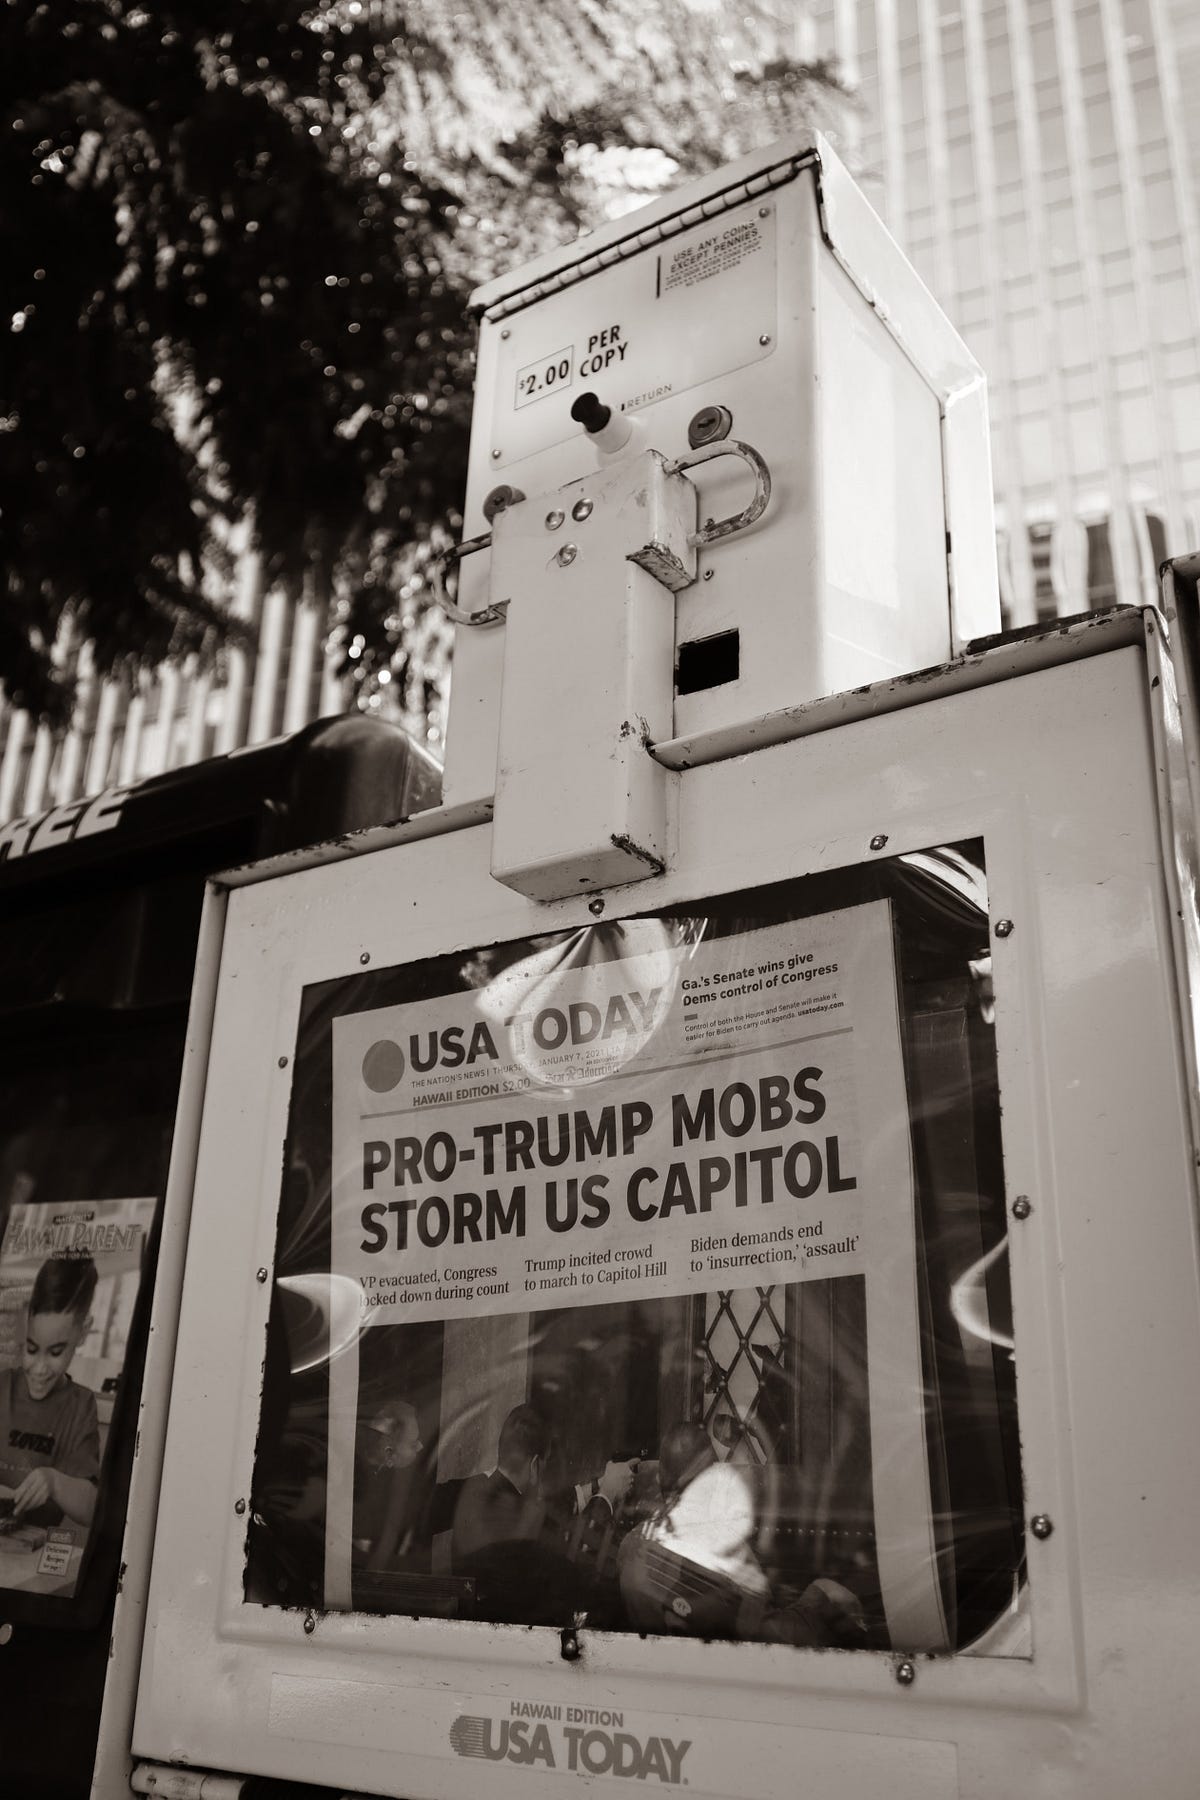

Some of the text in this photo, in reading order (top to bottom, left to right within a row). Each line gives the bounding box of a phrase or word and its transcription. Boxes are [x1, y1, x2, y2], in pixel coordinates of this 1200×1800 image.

[670, 250, 708, 273] EXCEPT
[714, 228, 758, 253] PENNIES
[674, 222, 755, 262] USE ANY COINS
[588, 325, 620, 353] PER
[519, 359, 570, 395] $2.00
[580, 342, 628, 378] COPY
[627, 384, 673, 408] RETURN
[682, 953, 814, 991] Ga.'s Senate wins give
[683, 962, 838, 1006] Dems control of Congress
[410, 986, 664, 1073] USA TODAY
[684, 992, 838, 1032] Control of both the House and Senate will make it
[686, 1032, 705, 1042] easier
[706, 1030, 716, 1039] for
[716, 1026, 735, 1036] Biden
[736, 1024, 742, 1032] to
[743, 1020, 760, 1032] carry
[760, 1018, 771, 1026] out
[798, 1000, 844, 1017] usatoday.com
[412, 1080, 425, 1088] THE
[426, 1073, 462, 1086] NATION'S
[464, 1070, 486, 1080] NEWS
[413, 1078, 531, 1107] HAWAII EDITION $2.00
[362, 1066, 826, 1190] PRO-TRUMP MOBS
[360, 1136, 857, 1254] STORM US CAPITOL
[73, 1223, 142, 1250] PARENT
[690, 1221, 824, 1253] Biden demands end
[690, 1258, 703, 1272] to
[802, 1234, 860, 1258] 'assault'
[524, 1261, 668, 1292] to march to Capitol Hill
[525, 1244, 654, 1274] Trump incited crowd
[360, 1266, 498, 1289] VP evacuated, Congress
[360, 1281, 510, 1307] locked down during count
[510, 1702, 624, 1728] HAWAII EDITION
[482, 1718, 556, 1769] USA
